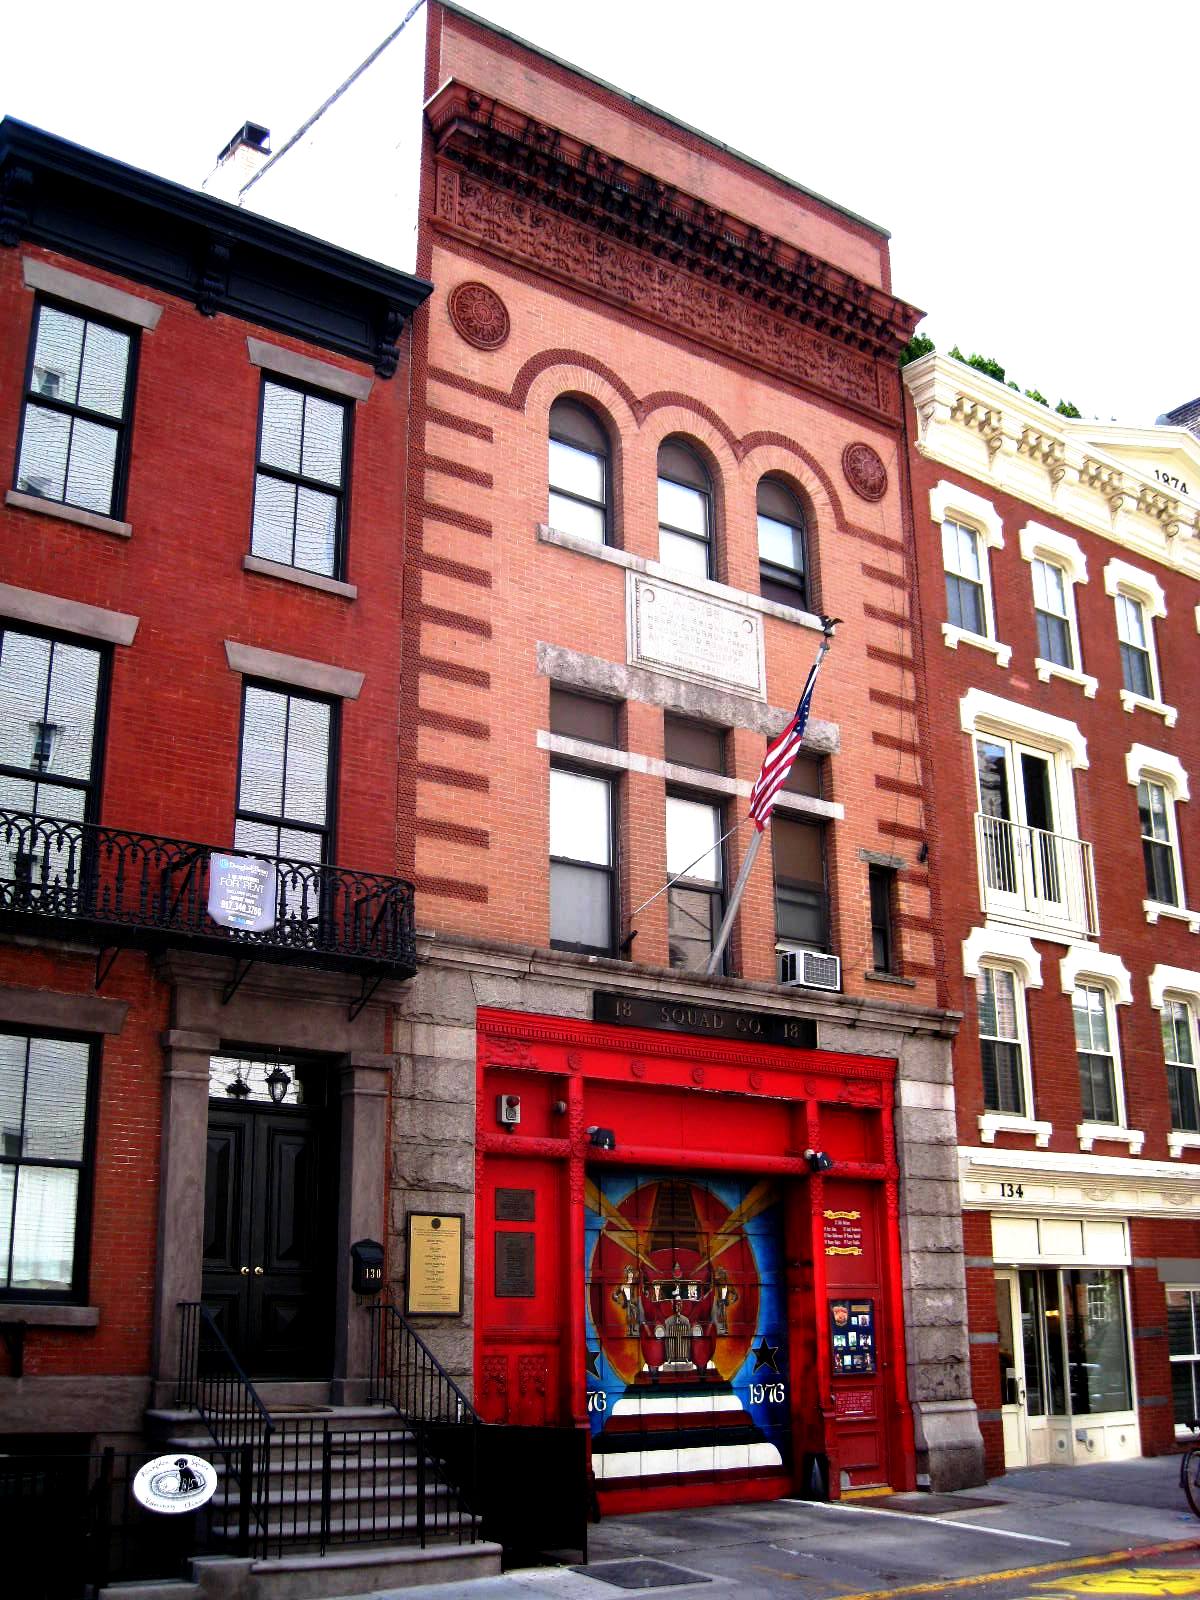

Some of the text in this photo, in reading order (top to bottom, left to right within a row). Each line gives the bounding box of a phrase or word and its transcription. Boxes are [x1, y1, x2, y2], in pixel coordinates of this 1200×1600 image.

[1154, 469, 1189, 495] 1974
[220, 876, 240, 888] FOR
[243, 880, 264, 893] RENT
[615, 1000, 799, 1038] 18 SQUAD CO. 18
[1000, 1182, 1024, 1199] 134
[365, 1268, 381, 1279] 130
[749, 1382, 785, 1404] 1976
